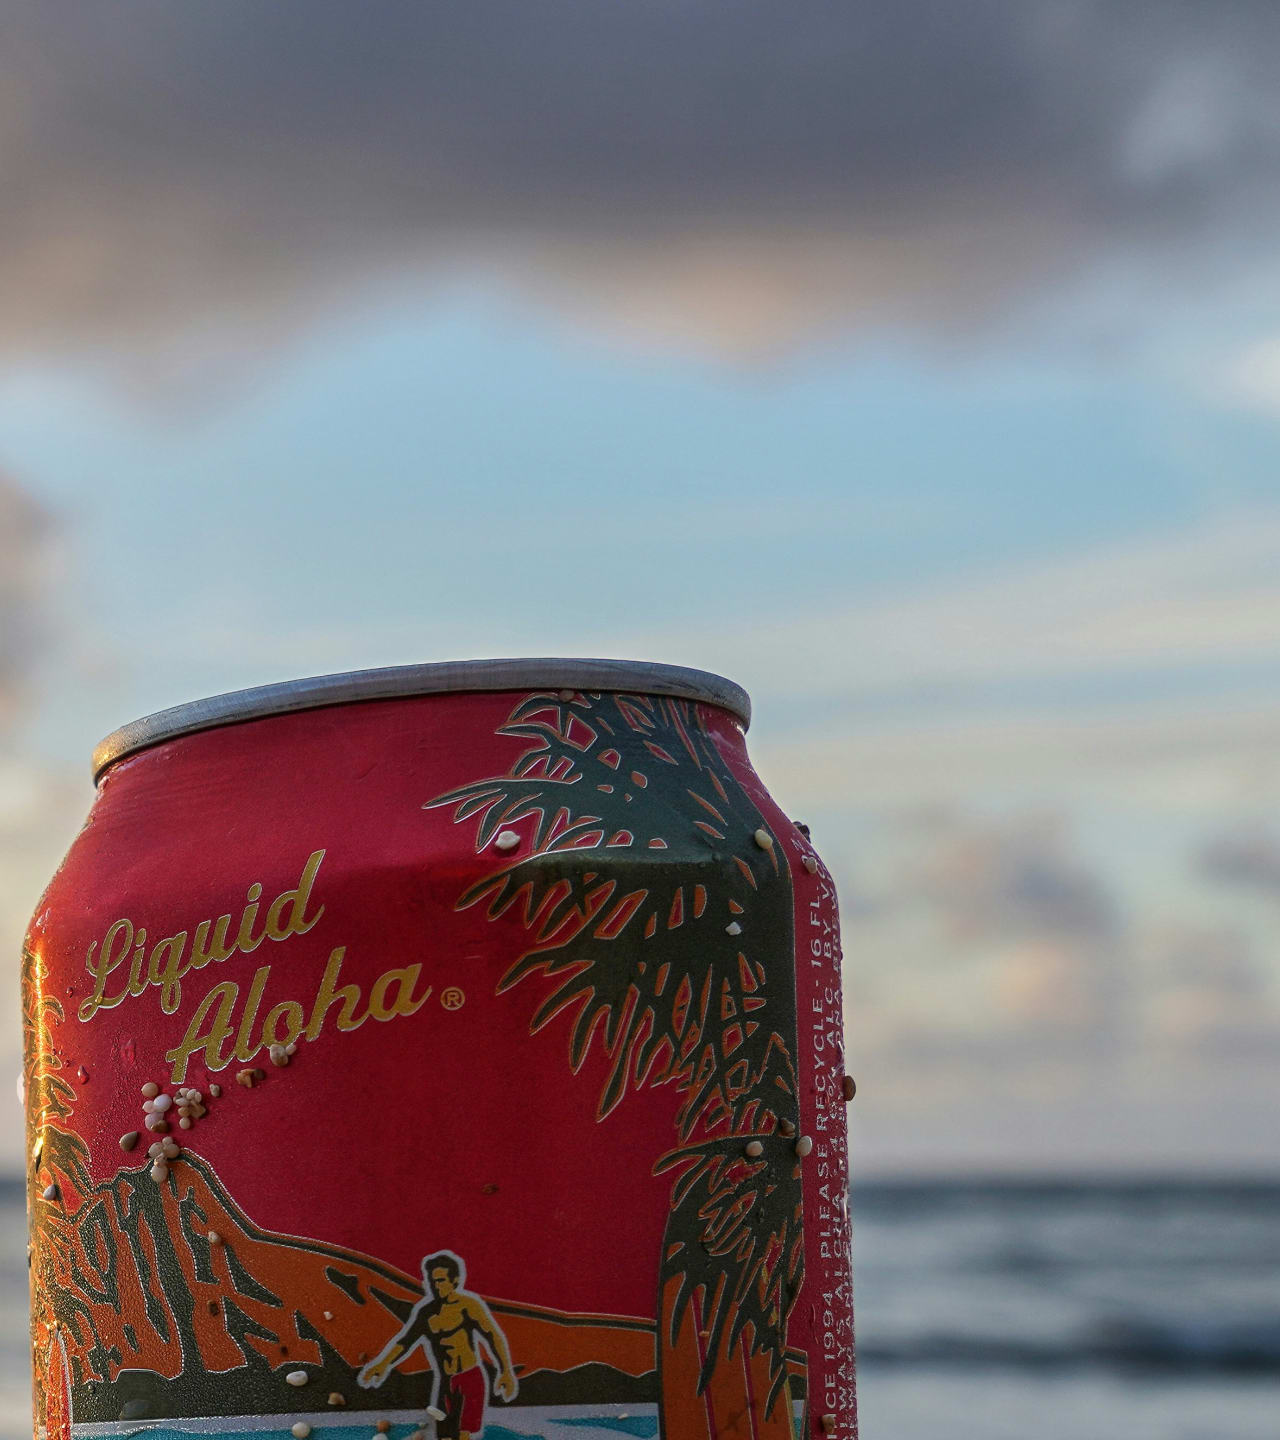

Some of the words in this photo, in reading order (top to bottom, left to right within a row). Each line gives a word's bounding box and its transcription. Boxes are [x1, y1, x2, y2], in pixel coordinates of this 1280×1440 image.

[78, 849, 326, 1022] Liquid
[810, 938, 822, 968] 16
[811, 998, 828, 1131] RECYCLE
[816, 1143, 831, 1259] PLEASE
[822, 1291, 836, 1360] 1994
